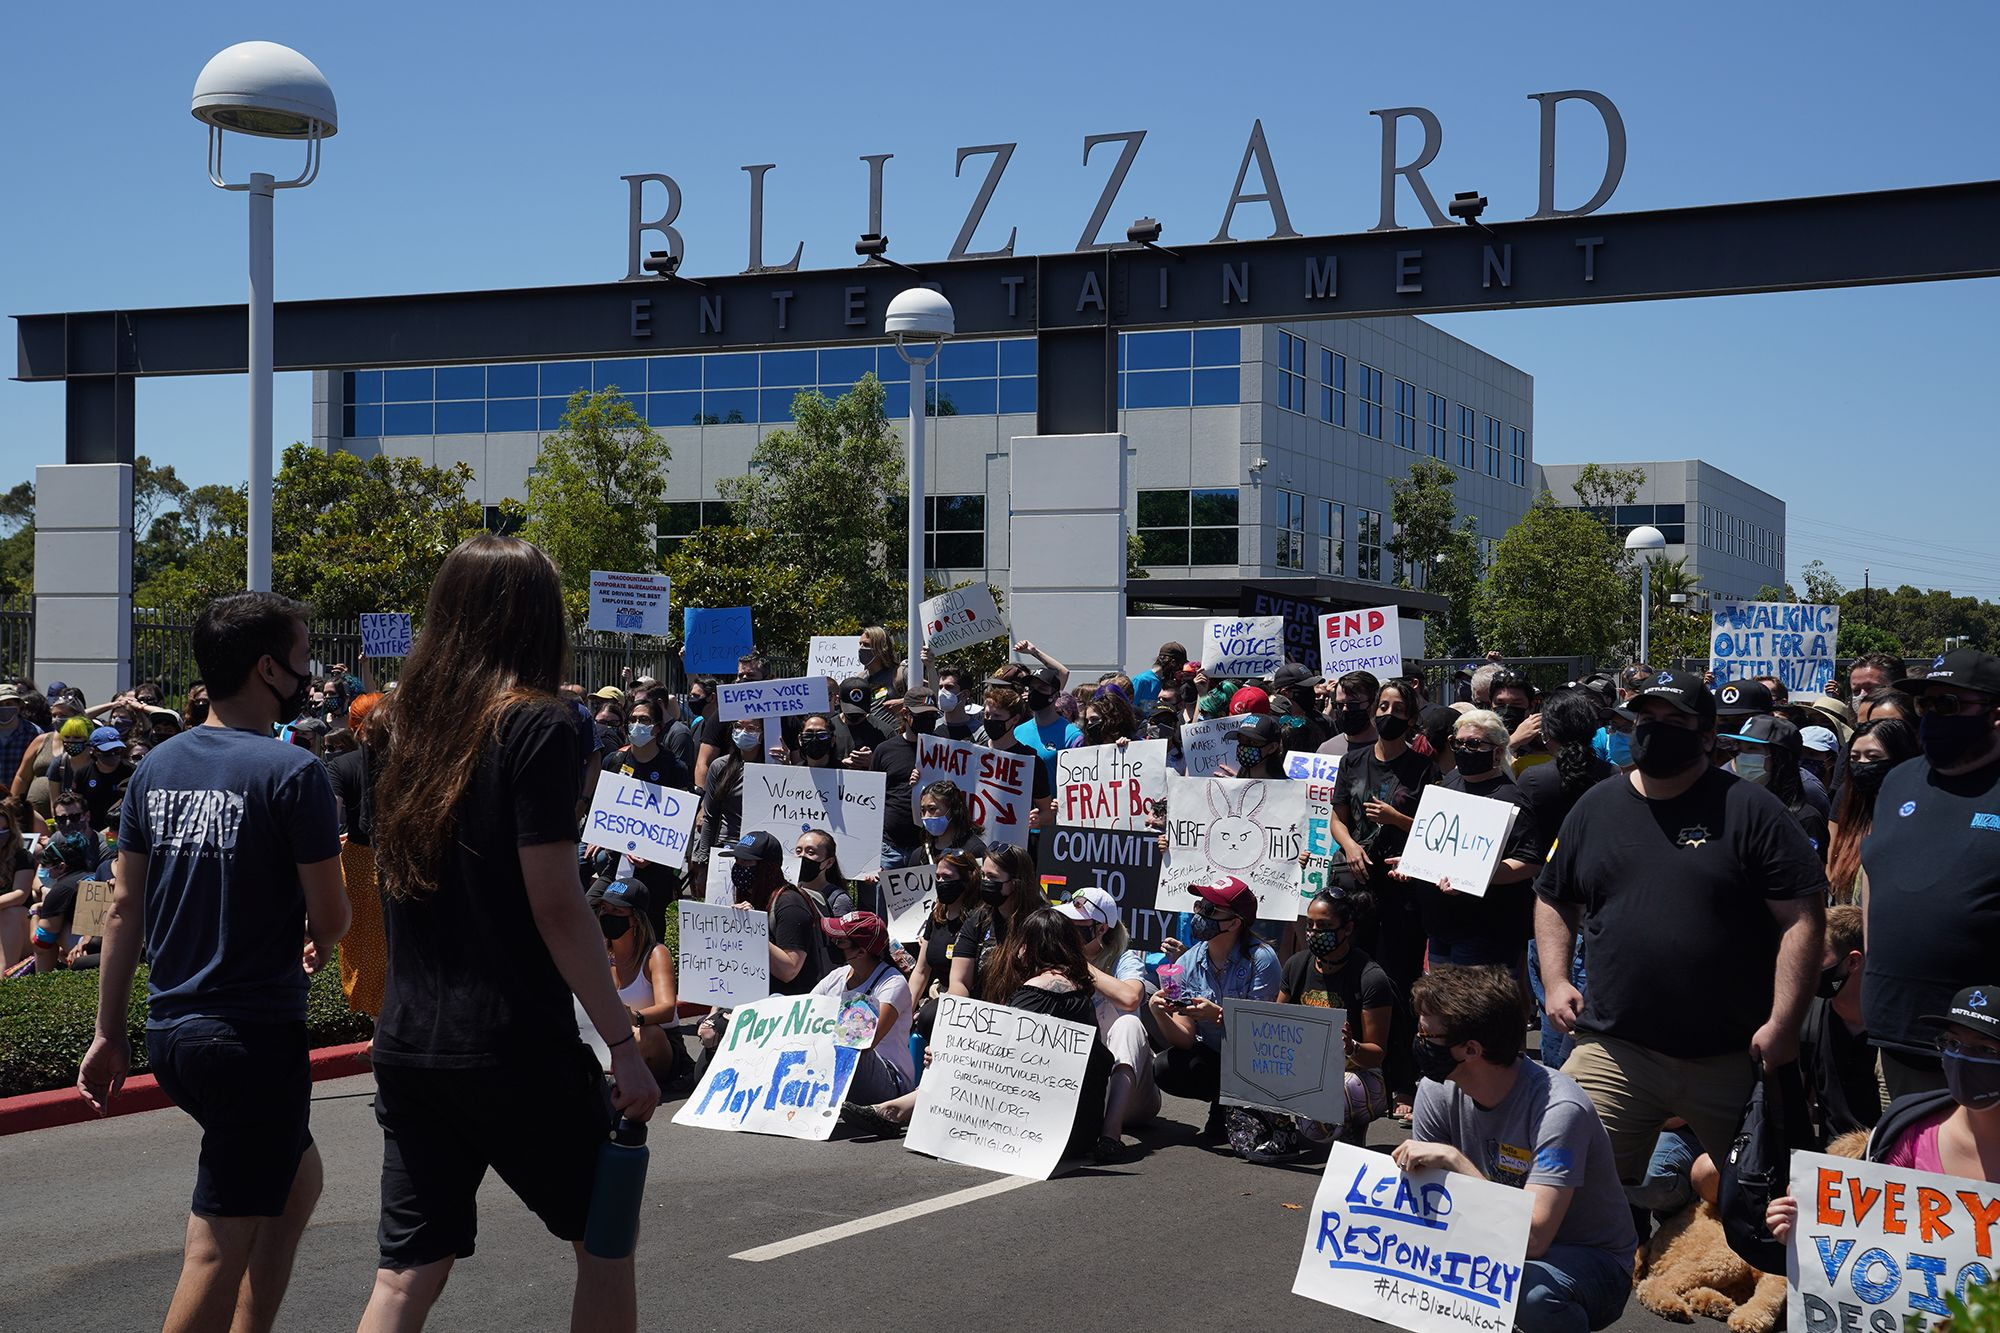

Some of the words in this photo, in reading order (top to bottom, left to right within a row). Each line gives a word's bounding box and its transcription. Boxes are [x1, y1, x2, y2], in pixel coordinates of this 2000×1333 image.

[620, 89, 1627, 282] BLIZZARD
[631, 236, 1604, 337] ENTETAINMENT
[593, 581, 628, 589] CORPORATE
[628, 584, 667, 592] BUREAUCRATS
[608, 574, 654, 583] UNACCOUNTABLE
[602, 598, 635, 606] EMPLOYEES
[611, 590, 635, 598] DRIVING
[932, 591, 966, 616] END
[361, 614, 410, 628] EVERY
[927, 608, 977, 636] FORCED
[927, 615, 1003, 650] ARBITRATION
[1213, 622, 1255, 639] EVERY
[1326, 610, 1385, 639] END
[362, 627, 410, 642] VOICE
[818, 641, 838, 651] FOR
[1219, 637, 1276, 656] VOICE
[1330, 634, 1383, 654] FORCED
[1714, 632, 1764, 657] OUT
[1771, 633, 1804, 657] FOR
[1810, 635, 1828, 656] A
[364, 640, 411, 655] MATTERS
[1214, 659, 1281, 675] MATTERS
[1325, 653, 1399, 674] ARBITRATION
[723, 688, 763, 703] EVERY
[773, 683, 810, 697] VOICE
[744, 698, 804, 713] MATTERS
[920, 738, 973, 776] WHAT
[979, 752, 1025, 787] SHE
[1059, 750, 1099, 787] Send
[1111, 748, 1143, 781] the
[1194, 752, 1229, 773] UPSET
[1288, 756, 1338, 782] Bliz
[616, 785, 680, 817] LEAD
[763, 776, 829, 802] Womens
[838, 785, 877, 811] Voices
[1066, 780, 1122, 820] FRAT
[147, 789, 244, 849] BLIZZARD
[773, 804, 829, 822] Matter
[1312, 805, 1329, 815] TO
[593, 810, 688, 852] RESPONSIBLY
[1168, 820, 1205, 847] NERF
[1415, 811, 1494, 861] EQALITY
[1053, 831, 1157, 867] COMMIT
[1308, 857, 1329, 868] THE
[888, 871, 933, 896] EQU
[1092, 869, 1126, 902] TO
[682, 911, 720, 935] FIGHT
[722, 913, 744, 934] BAD
[744, 916, 767, 938] GUYS
[705, 936, 719, 950] IN
[719, 937, 743, 952] GAME
[681, 952, 713, 972] FIGHT
[716, 957, 738, 974] BAD
[741, 962, 766, 981] GUYS
[709, 977, 734, 995] IRL
[728, 1008, 784, 1051] Play
[782, 998, 837, 1037] Nice
[939, 997, 1012, 1037] PLEASE
[1016, 1016, 1090, 1056] DONATE
[1252, 1021, 1304, 1045] WOMENS
[1253, 1042, 1295, 1062] VOICES
[1252, 1059, 1297, 1077] MATTER
[695, 1067, 763, 1125] Play
[763, 1044, 861, 1118] Fair!
[950, 1086, 1030, 1120] RAINN.ORG
[1345, 1163, 1453, 1217] LEAD
[1817, 1166, 2000, 1259] EVERY
[1316, 1210, 1522, 1303] RESPONSIBLY
[1809, 1235, 1993, 1318] VOIC
